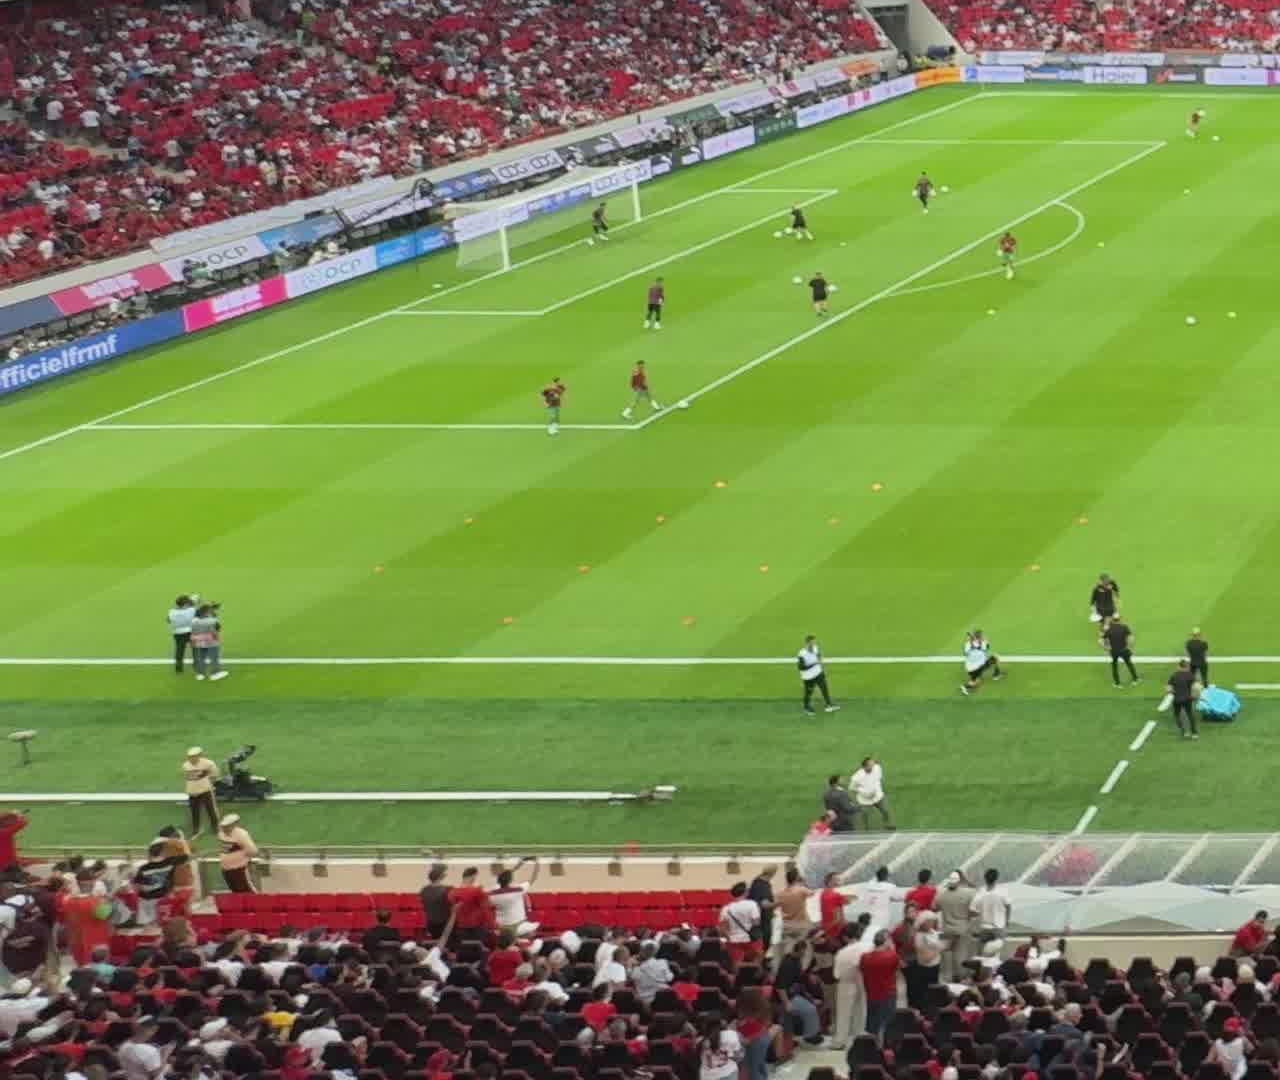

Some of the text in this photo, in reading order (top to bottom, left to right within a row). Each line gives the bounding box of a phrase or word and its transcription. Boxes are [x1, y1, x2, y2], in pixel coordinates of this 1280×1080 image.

[207, 245, 249, 266] OCP
[325, 258, 361, 279] OCP
[0, 334, 118, 388] fficielfrmf
